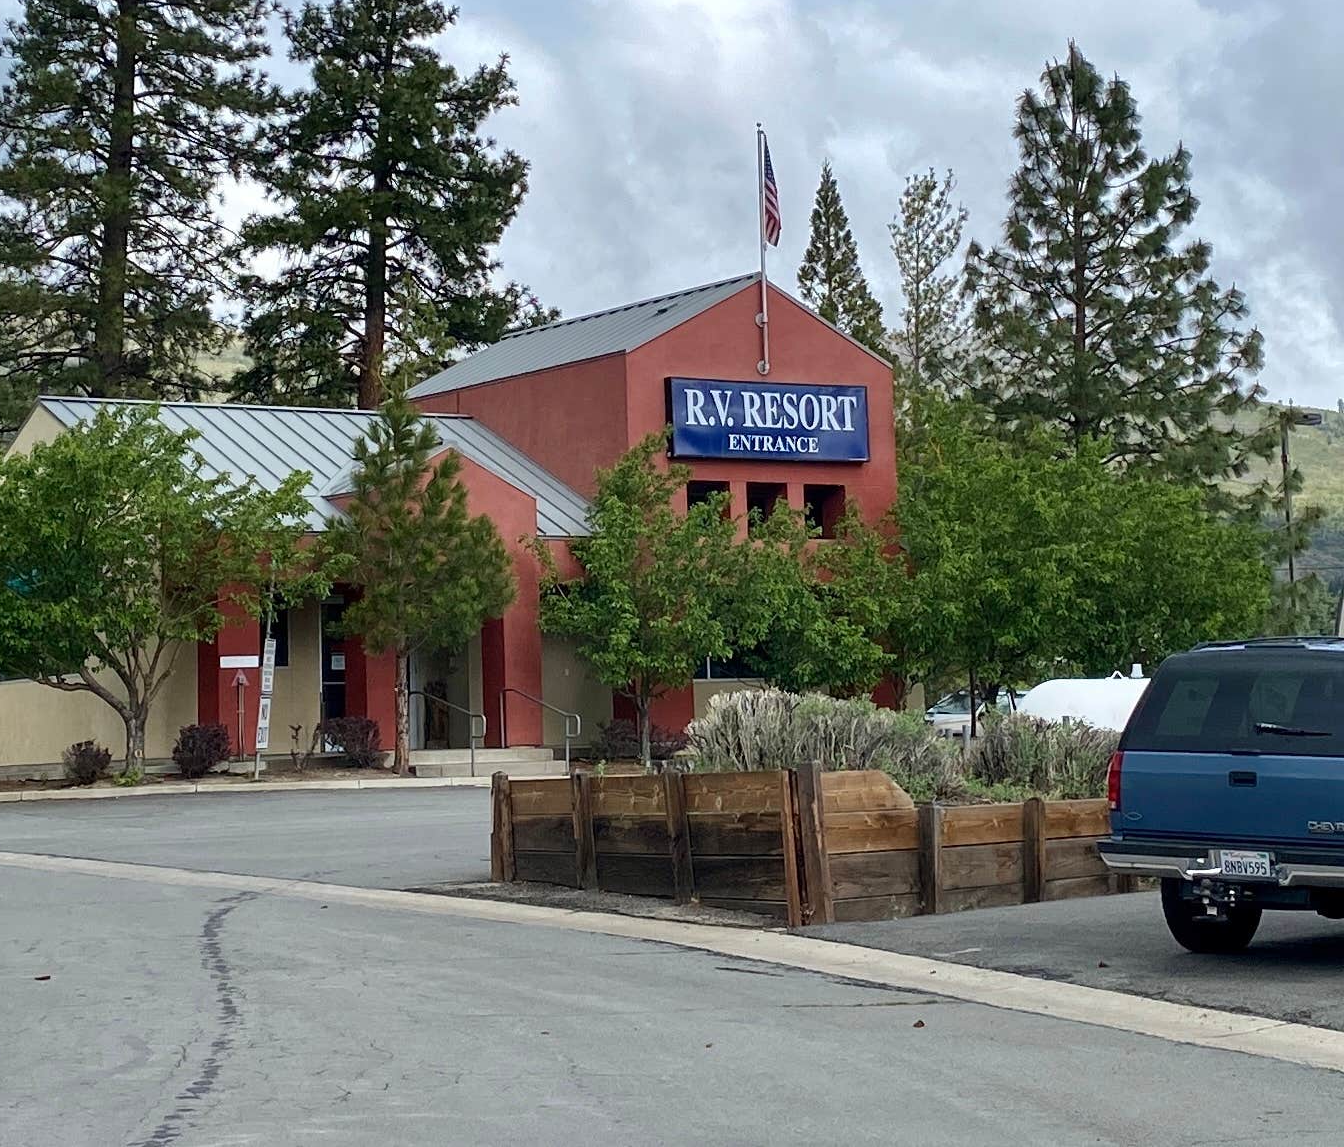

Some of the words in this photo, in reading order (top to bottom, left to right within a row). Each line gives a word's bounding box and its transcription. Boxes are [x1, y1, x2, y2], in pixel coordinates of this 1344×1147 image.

[684, 388, 734, 427] R.V.
[740, 391, 857, 432] RESORT
[728, 434, 819, 453] ENTRANCE
[1224, 859, 1267, 875] 8NBV595
